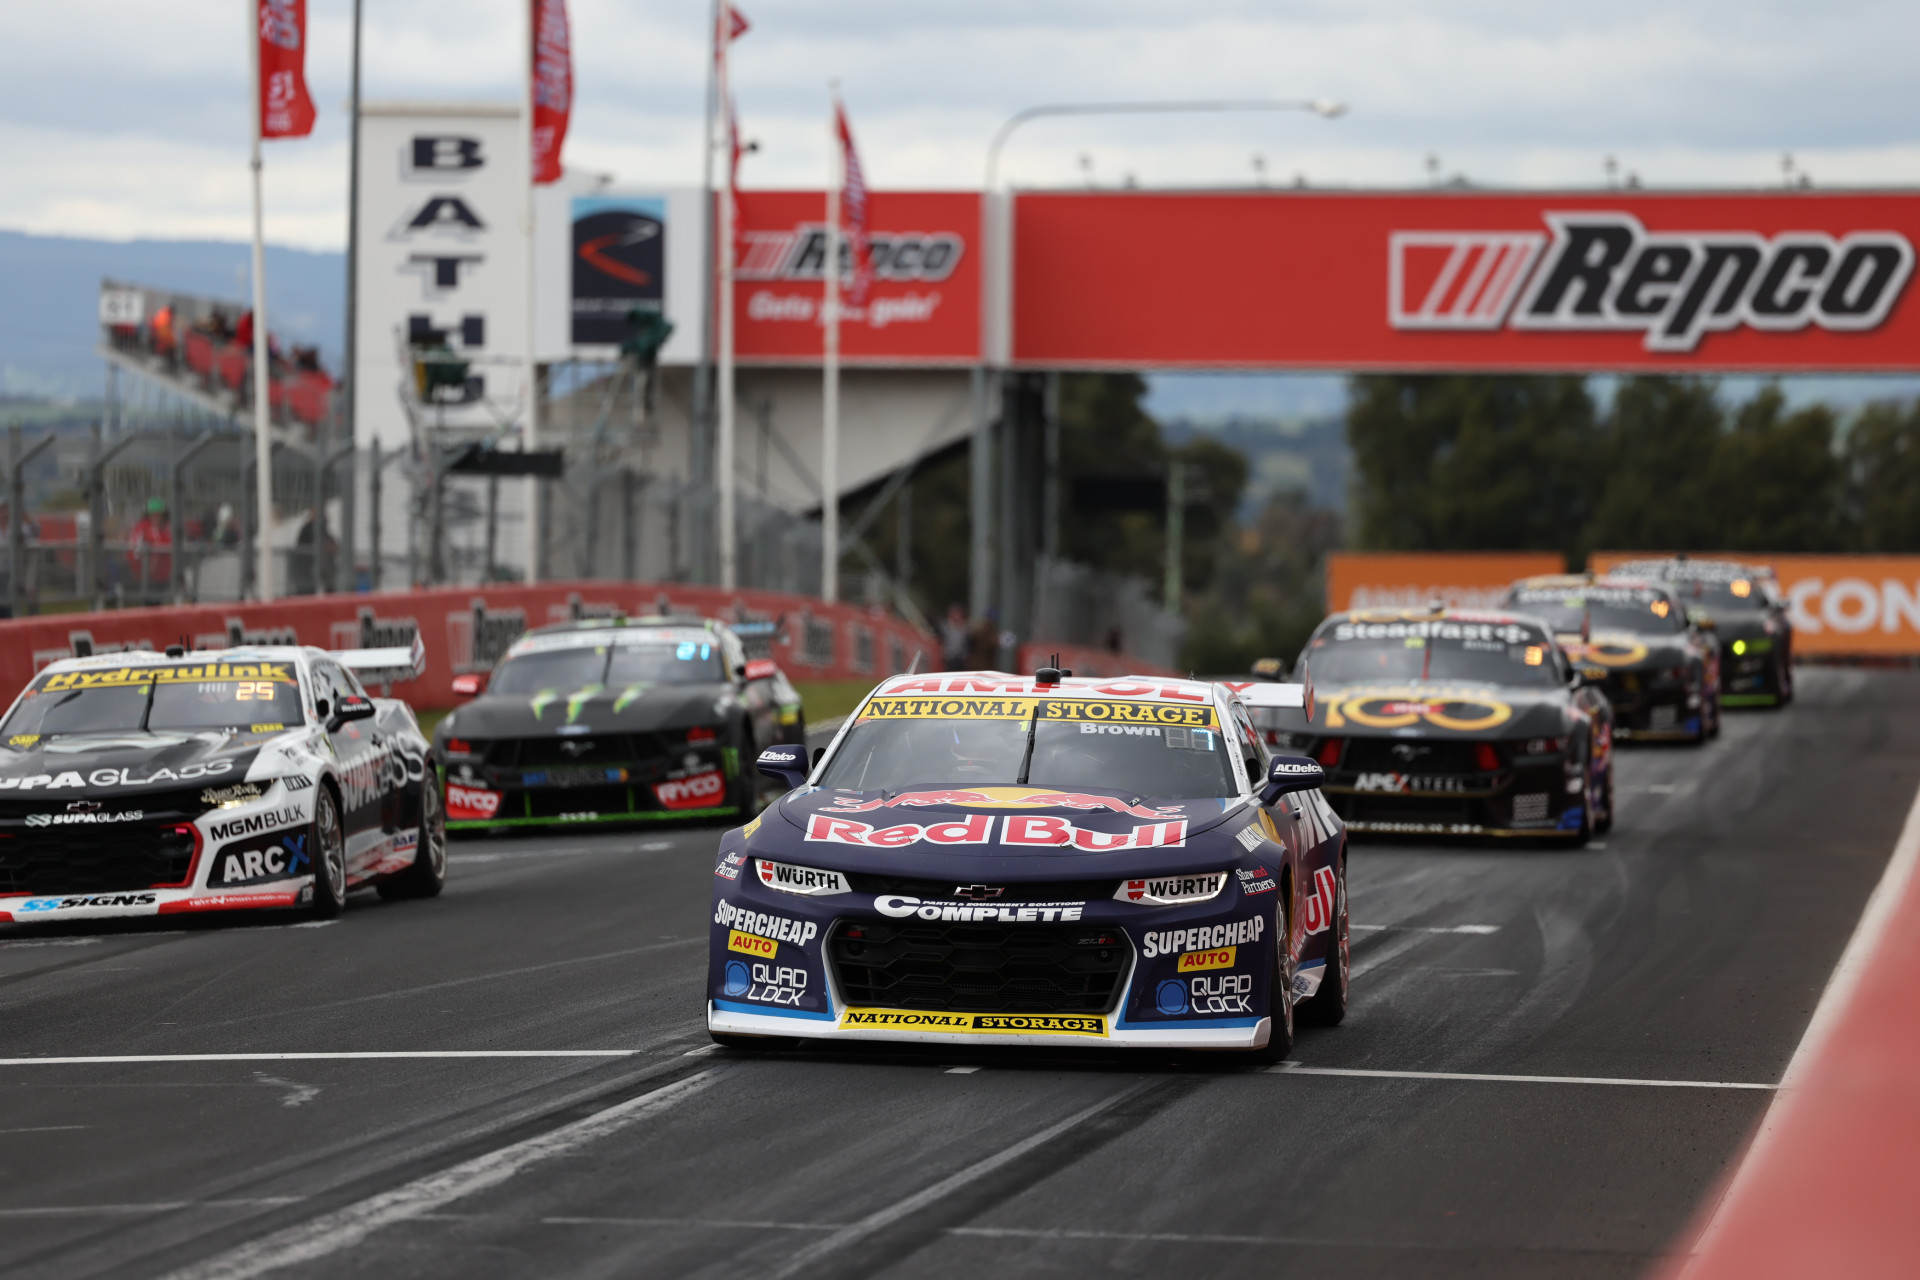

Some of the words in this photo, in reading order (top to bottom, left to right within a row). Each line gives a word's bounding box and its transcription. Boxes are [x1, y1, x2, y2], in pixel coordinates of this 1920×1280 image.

[1508, 211, 1914, 352] Repco
[46, 662, 289, 688] Hydraulink
[236, 682, 275, 700] 25
[867, 700, 1027, 717] NATIONAL
[1046, 702, 1204, 725] STORAGE
[1080, 723, 1161, 737] Brown
[1275, 763, 1323, 773] ACDelco
[657, 774, 721, 804] RYCO
[53, 810, 144, 825] SUPAGLASS
[804, 814, 995, 848] Red
[1000, 815, 1188, 852] Bull
[1241, 878, 1276, 894] Partners
[874, 895, 1083, 922] COMPLETE
[714, 898, 818, 947] SUPERCHEAP
[733, 936, 772, 953] AUTO
[1143, 915, 1264, 958] SUPERCHEAP
[1183, 952, 1230, 967] AUTO
[752, 963, 808, 989] QUAD
[1191, 974, 1252, 996] QUAD
[747, 984, 806, 1006] LOCK
[1191, 995, 1253, 1014] LOCK
[845, 1012, 969, 1027] NATIONAL
[981, 1016, 1098, 1031] STORAGE
